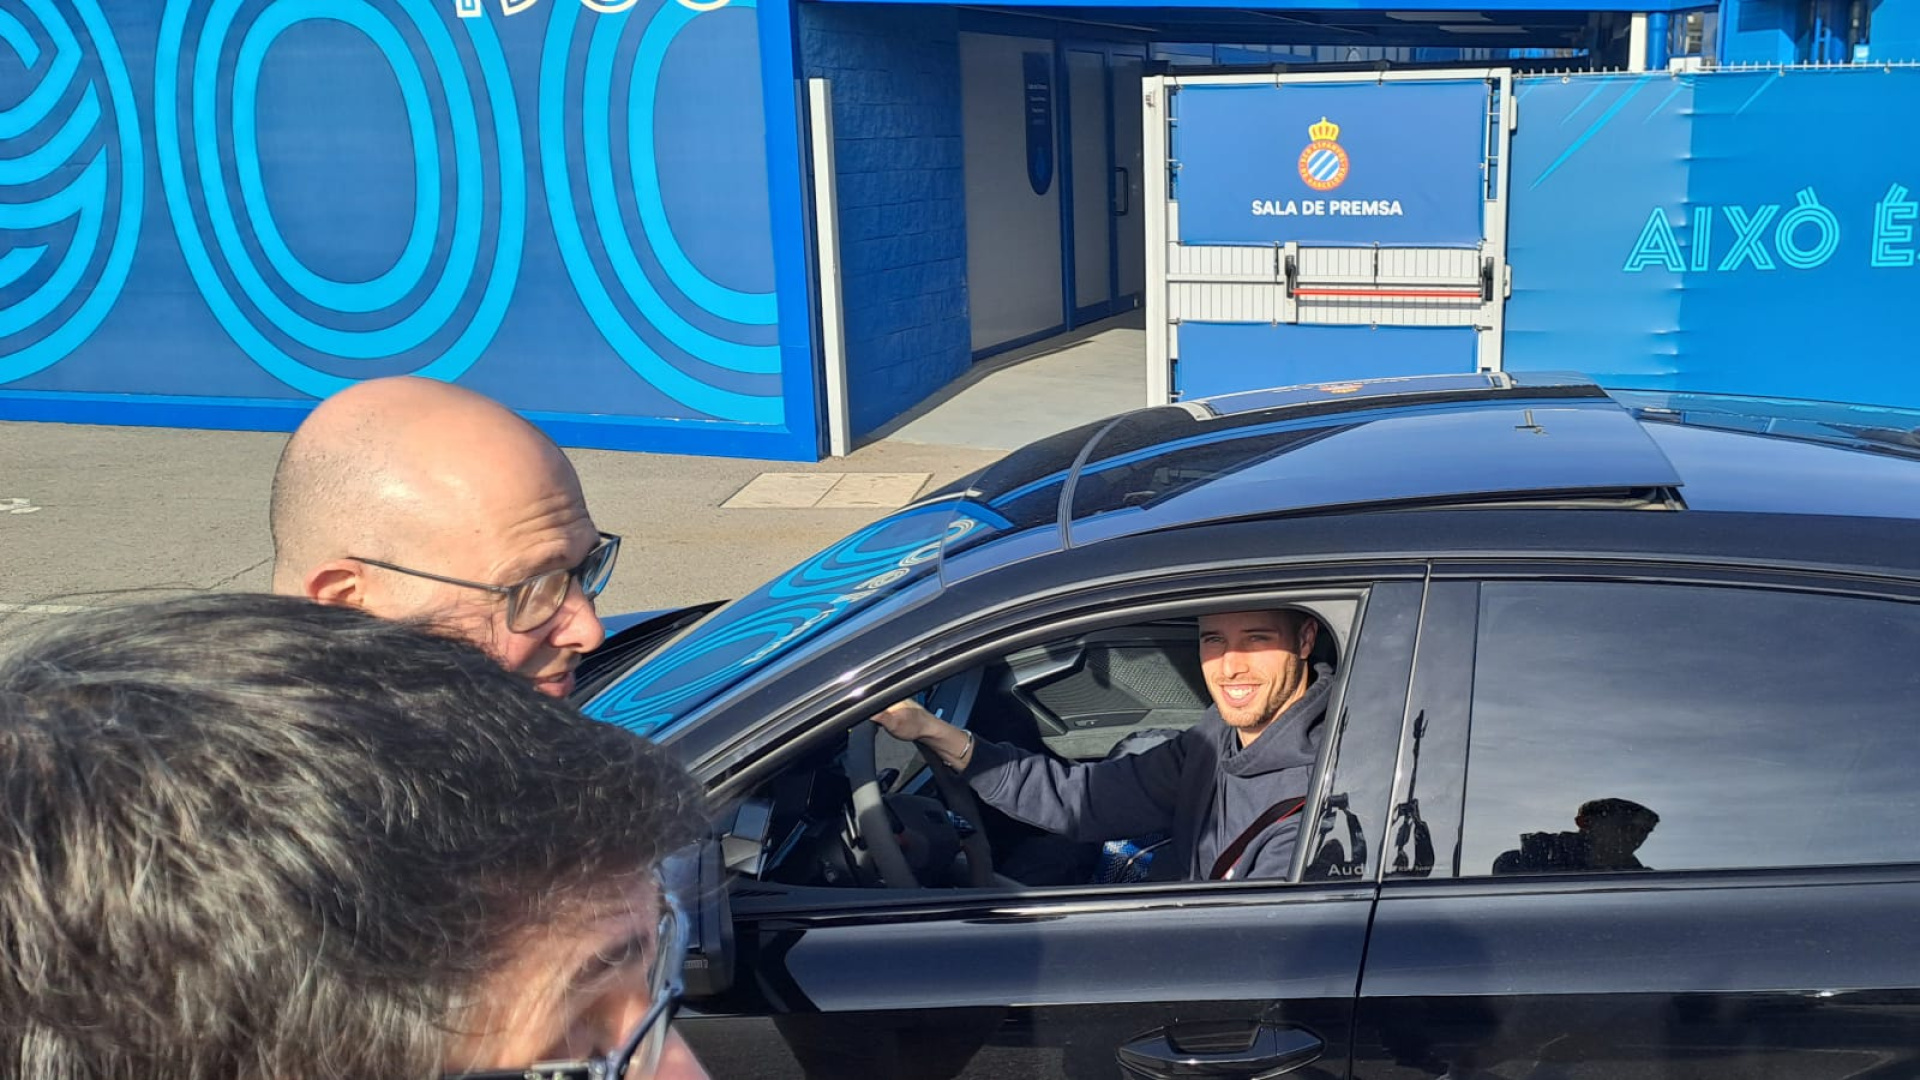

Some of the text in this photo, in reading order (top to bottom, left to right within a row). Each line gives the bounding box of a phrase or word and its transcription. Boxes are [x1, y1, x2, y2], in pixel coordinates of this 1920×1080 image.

[1251, 199, 1403, 216] SALA DE PREMSA
[1623, 183, 1920, 271] AIXÒ É
